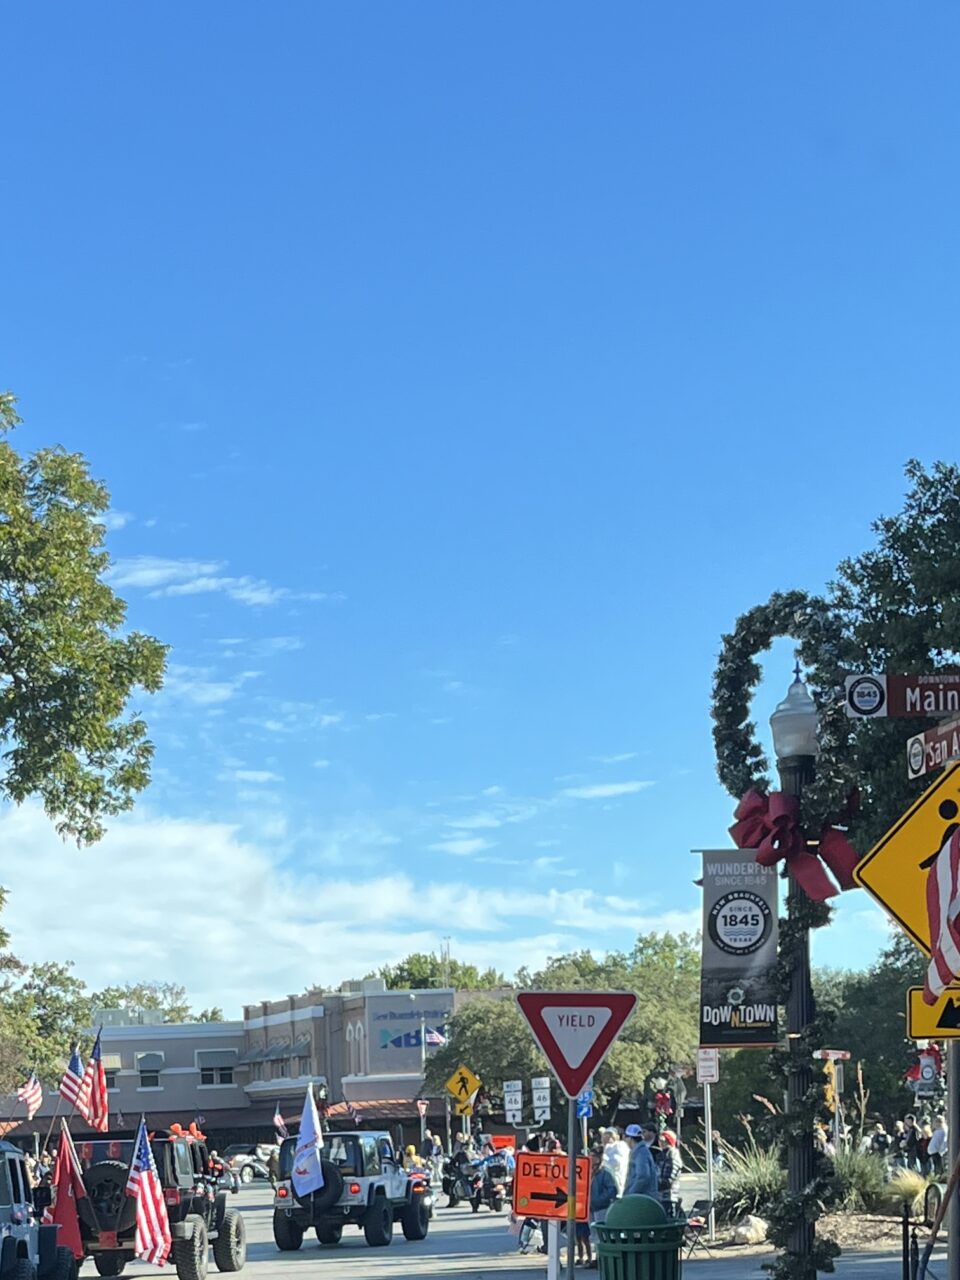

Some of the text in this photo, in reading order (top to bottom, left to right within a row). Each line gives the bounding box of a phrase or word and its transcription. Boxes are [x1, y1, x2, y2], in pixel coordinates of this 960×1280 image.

[906, 683, 959, 712] Main
[929, 740, 947, 767] San
[951, 731, 960, 757] A
[706, 863, 774, 876] WUNDERFUL
[715, 876, 742, 886] SINCE
[712, 898, 726, 916] NEW
[722, 914, 760, 927] 1845
[557, 1014, 595, 1028] YIELD
[703, 1004, 775, 1028] DOWNTOWN
[508, 1097, 519, 1106] 46
[536, 1094, 547, 1102] 46
